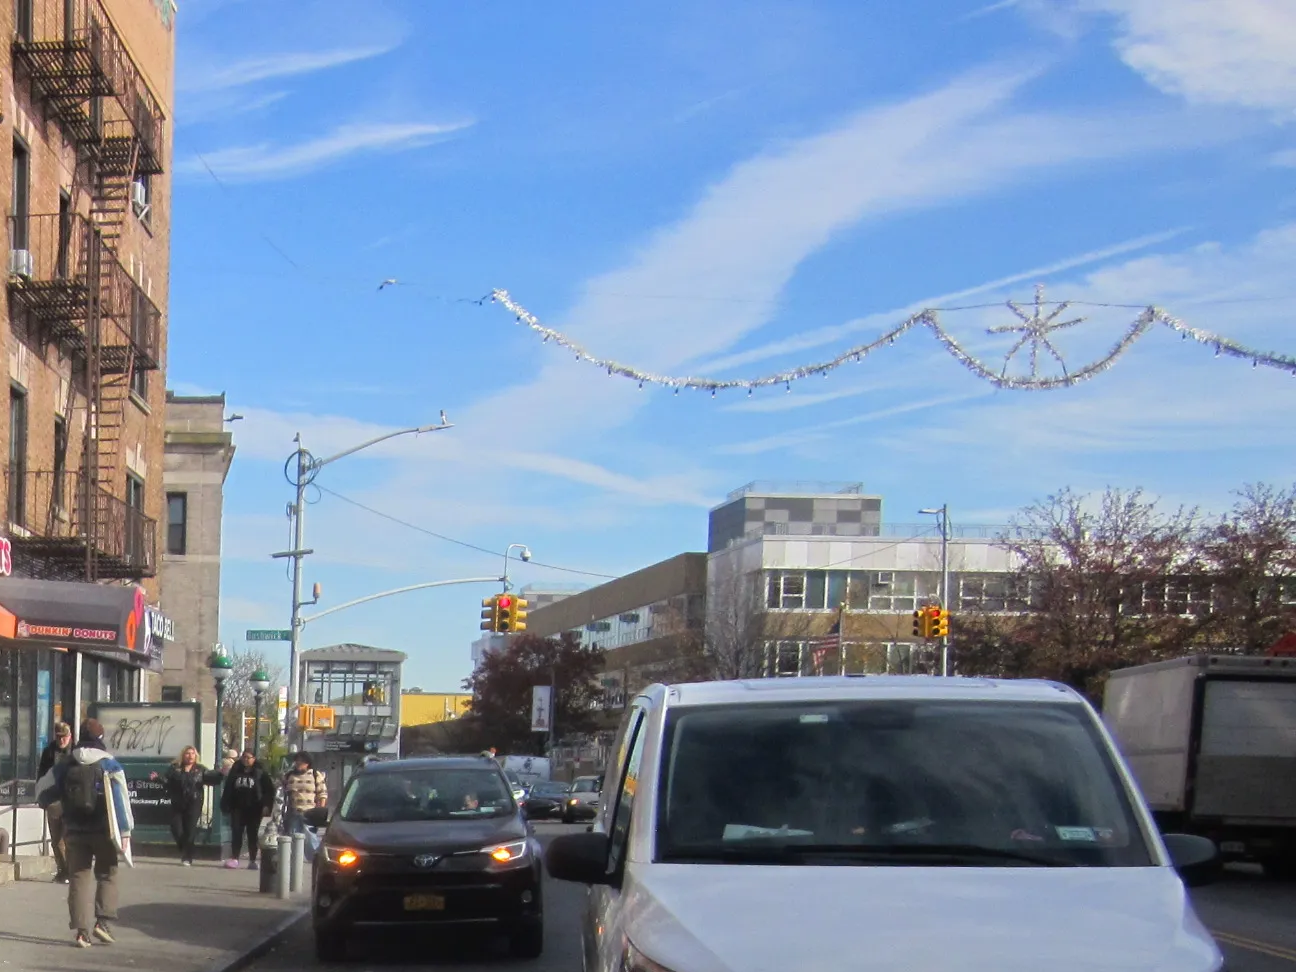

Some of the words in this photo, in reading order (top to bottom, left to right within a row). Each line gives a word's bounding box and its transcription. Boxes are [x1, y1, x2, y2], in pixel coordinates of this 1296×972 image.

[29, 626, 73, 637] DUNKIN'
[73, 628, 117, 641] DONUTS
[151, 611, 164, 638] TACO
[163, 617, 175, 642] BELL
